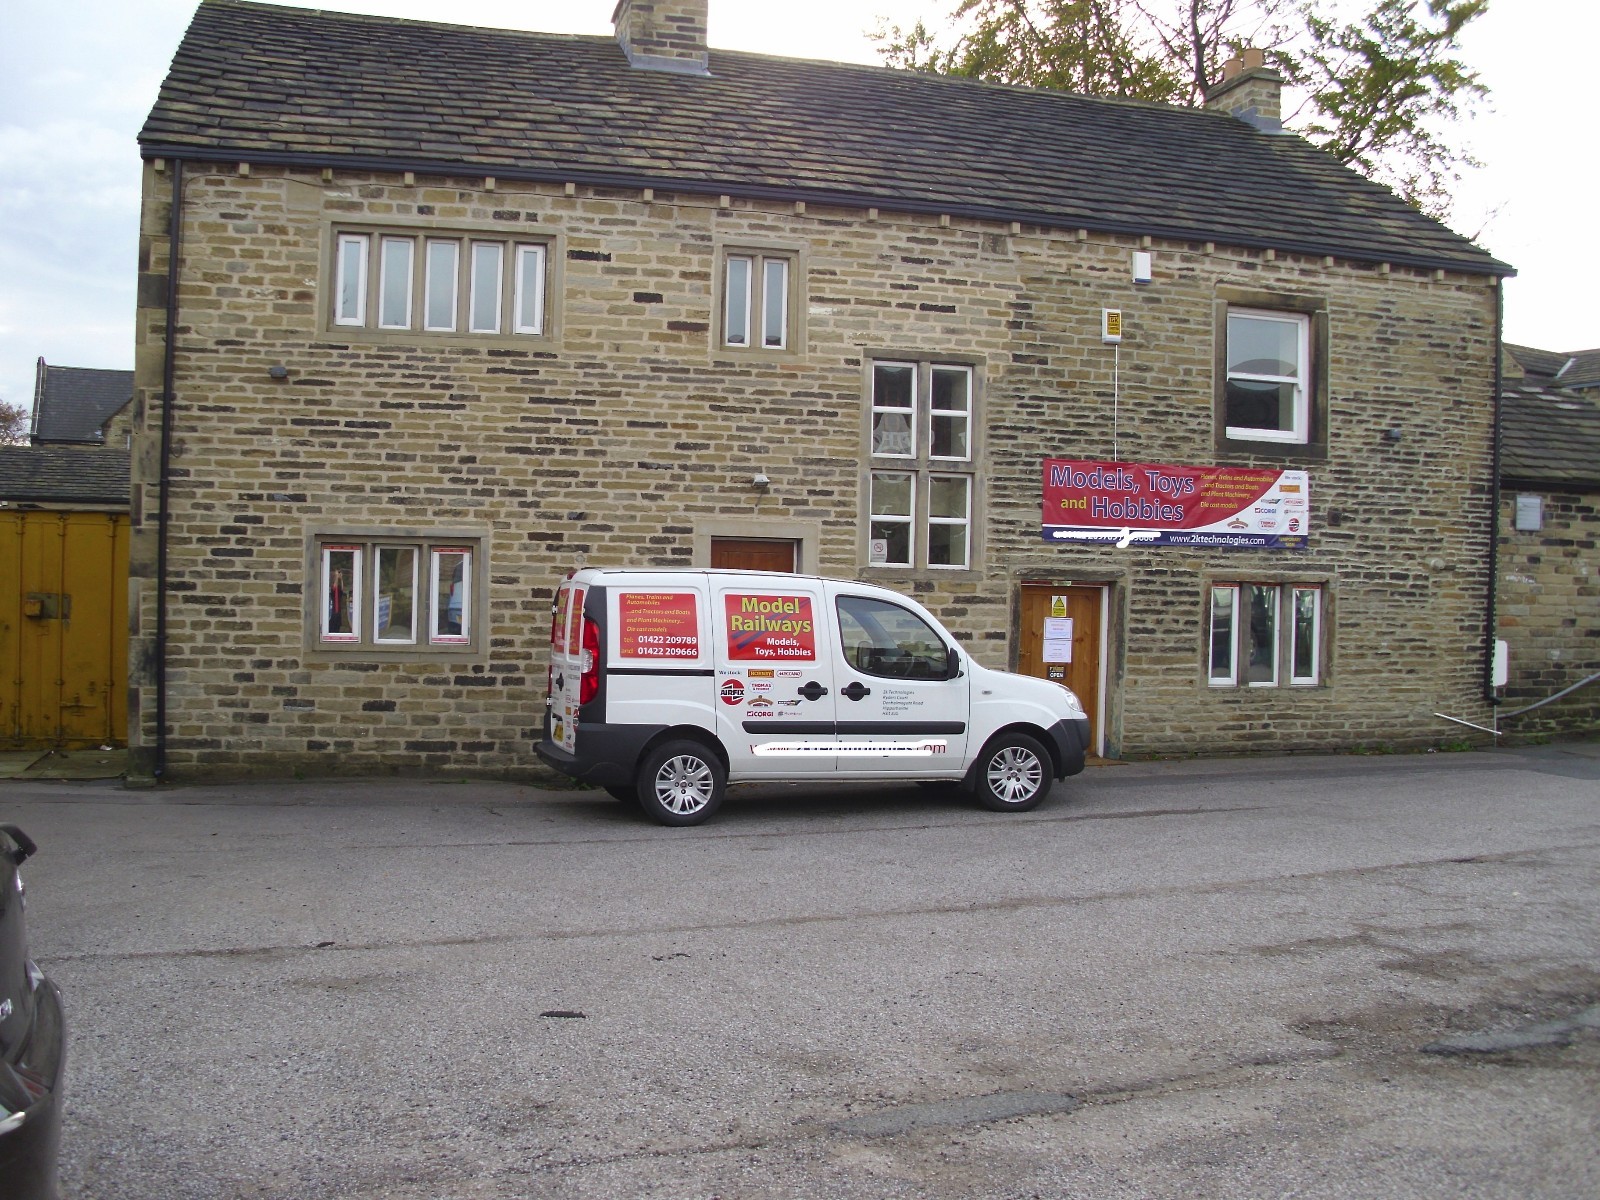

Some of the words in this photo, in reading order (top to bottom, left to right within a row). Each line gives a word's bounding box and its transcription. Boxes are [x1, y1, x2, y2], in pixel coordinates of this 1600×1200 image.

[1050, 465, 1140, 494] Models,
[1145, 470, 1195, 498] Toys
[1060, 497, 1087, 509] and
[1091, 496, 1184, 521] Hobbies
[1169, 534, 1265, 546] www.2ktechnologies.com
[741, 597, 799, 614] Model
[731, 615, 811, 636] Railways
[638, 635, 664, 644] 01422
[665, 636, 697, 645] 209789
[766, 637, 800, 647] Models,
[637, 647, 664, 656] 01422
[665, 647, 697, 656] 209666
[755, 648, 776, 657] Toys,
[777, 648, 811, 657] Hobbies
